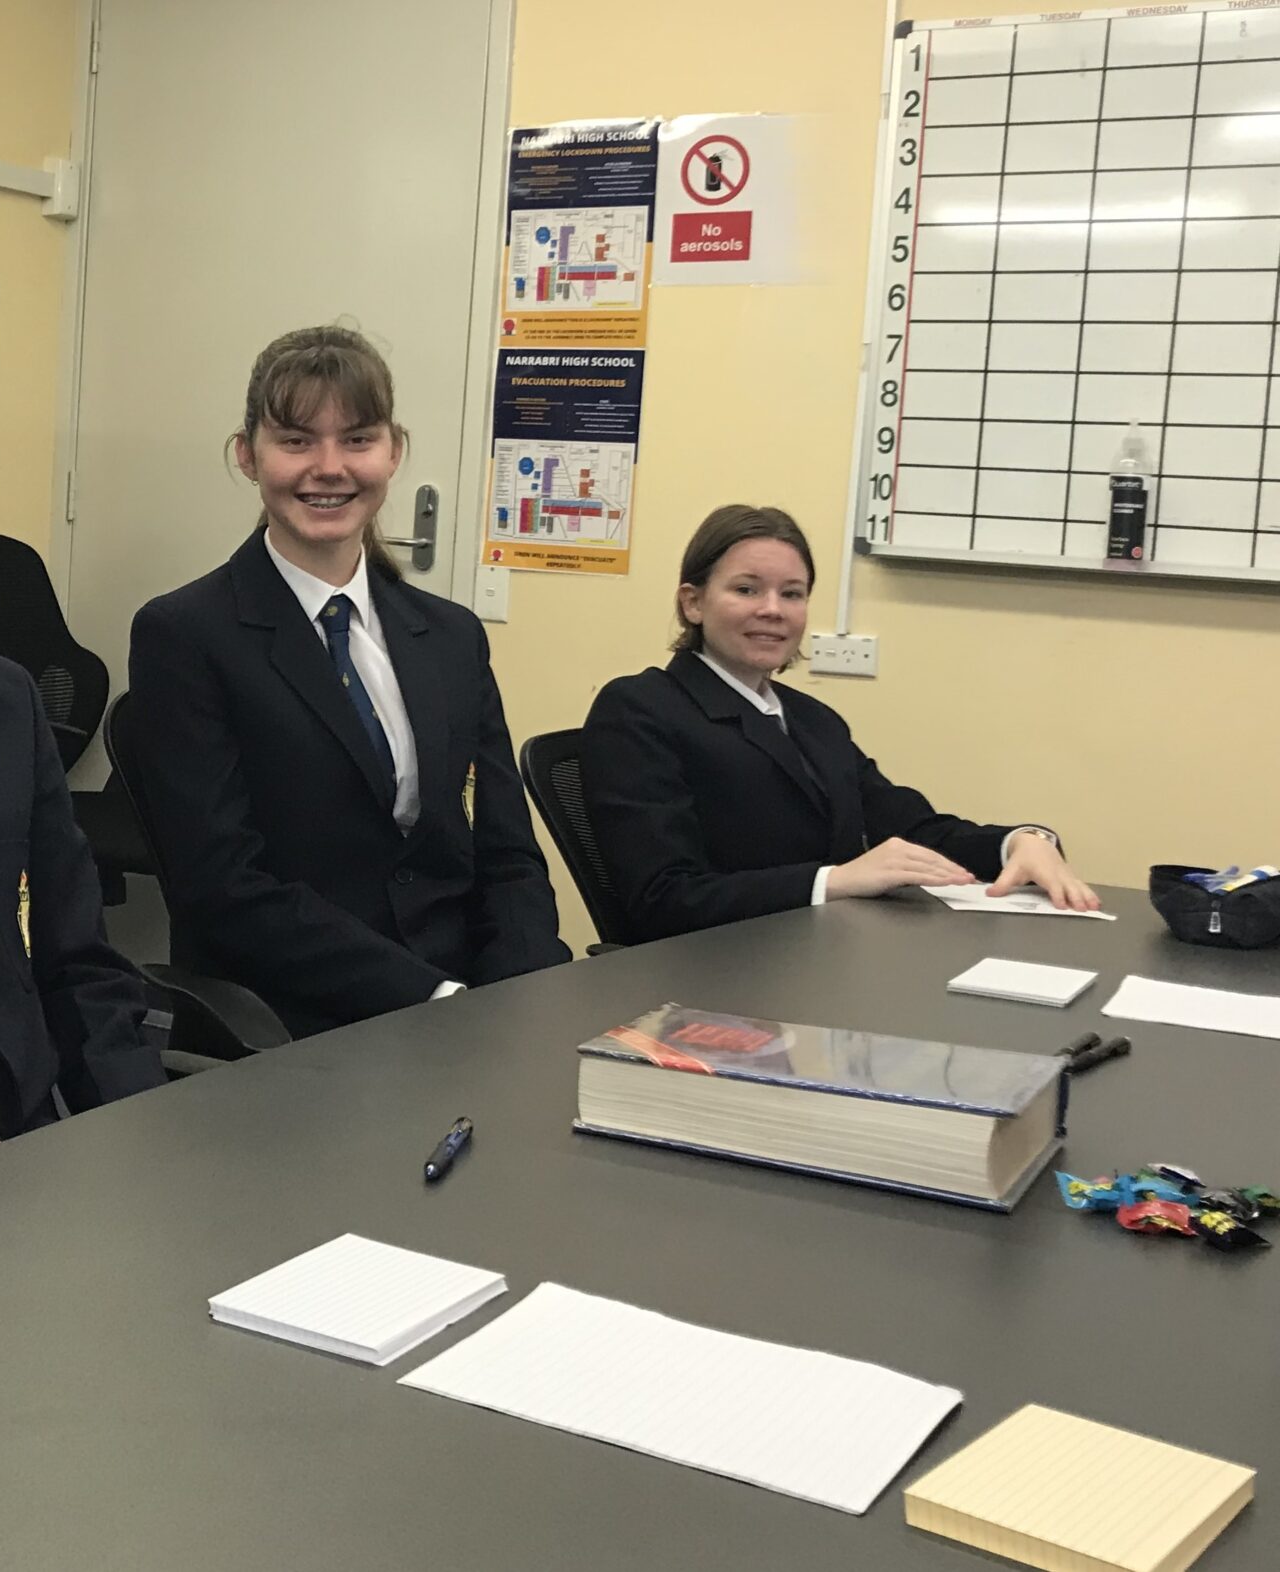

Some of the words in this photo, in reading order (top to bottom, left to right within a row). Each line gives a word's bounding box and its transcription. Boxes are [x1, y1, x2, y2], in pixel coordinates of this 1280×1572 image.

[953, 18, 993, 27] MONDAY
[1039, 11, 1083, 22] TUESDAY
[1126, 5, 1189, 17] WEDNESDAY
[909, 44, 921, 72] 1
[903, 89, 921, 118] 2
[577, 132, 604, 144] HIGH
[606, 130, 651, 142] SCHOOL
[518, 149, 560, 158] EMERGENCY
[561, 147, 604, 157] LOCKDOWN
[604, 145, 652, 155] PROCEDURES
[898, 138, 918, 166] 3
[894, 187, 913, 215] 4
[701, 223, 722, 237] No
[679, 238, 744, 253] aerosols
[891, 235, 910, 263] 5
[887, 283, 907, 312] 6
[505, 356, 561, 367] NARRABRI
[561, 356, 590, 367] HIGH
[590, 357, 637, 368] SCHOOL
[886, 334, 903, 364] 7
[511, 377, 568, 387] EVACUATION
[568, 378, 627, 388] PROCEDURES
[880, 379, 899, 407] 8
[877, 426, 895, 454] 9
[869, 473, 893, 501] 10
[867, 514, 890, 541] 11
